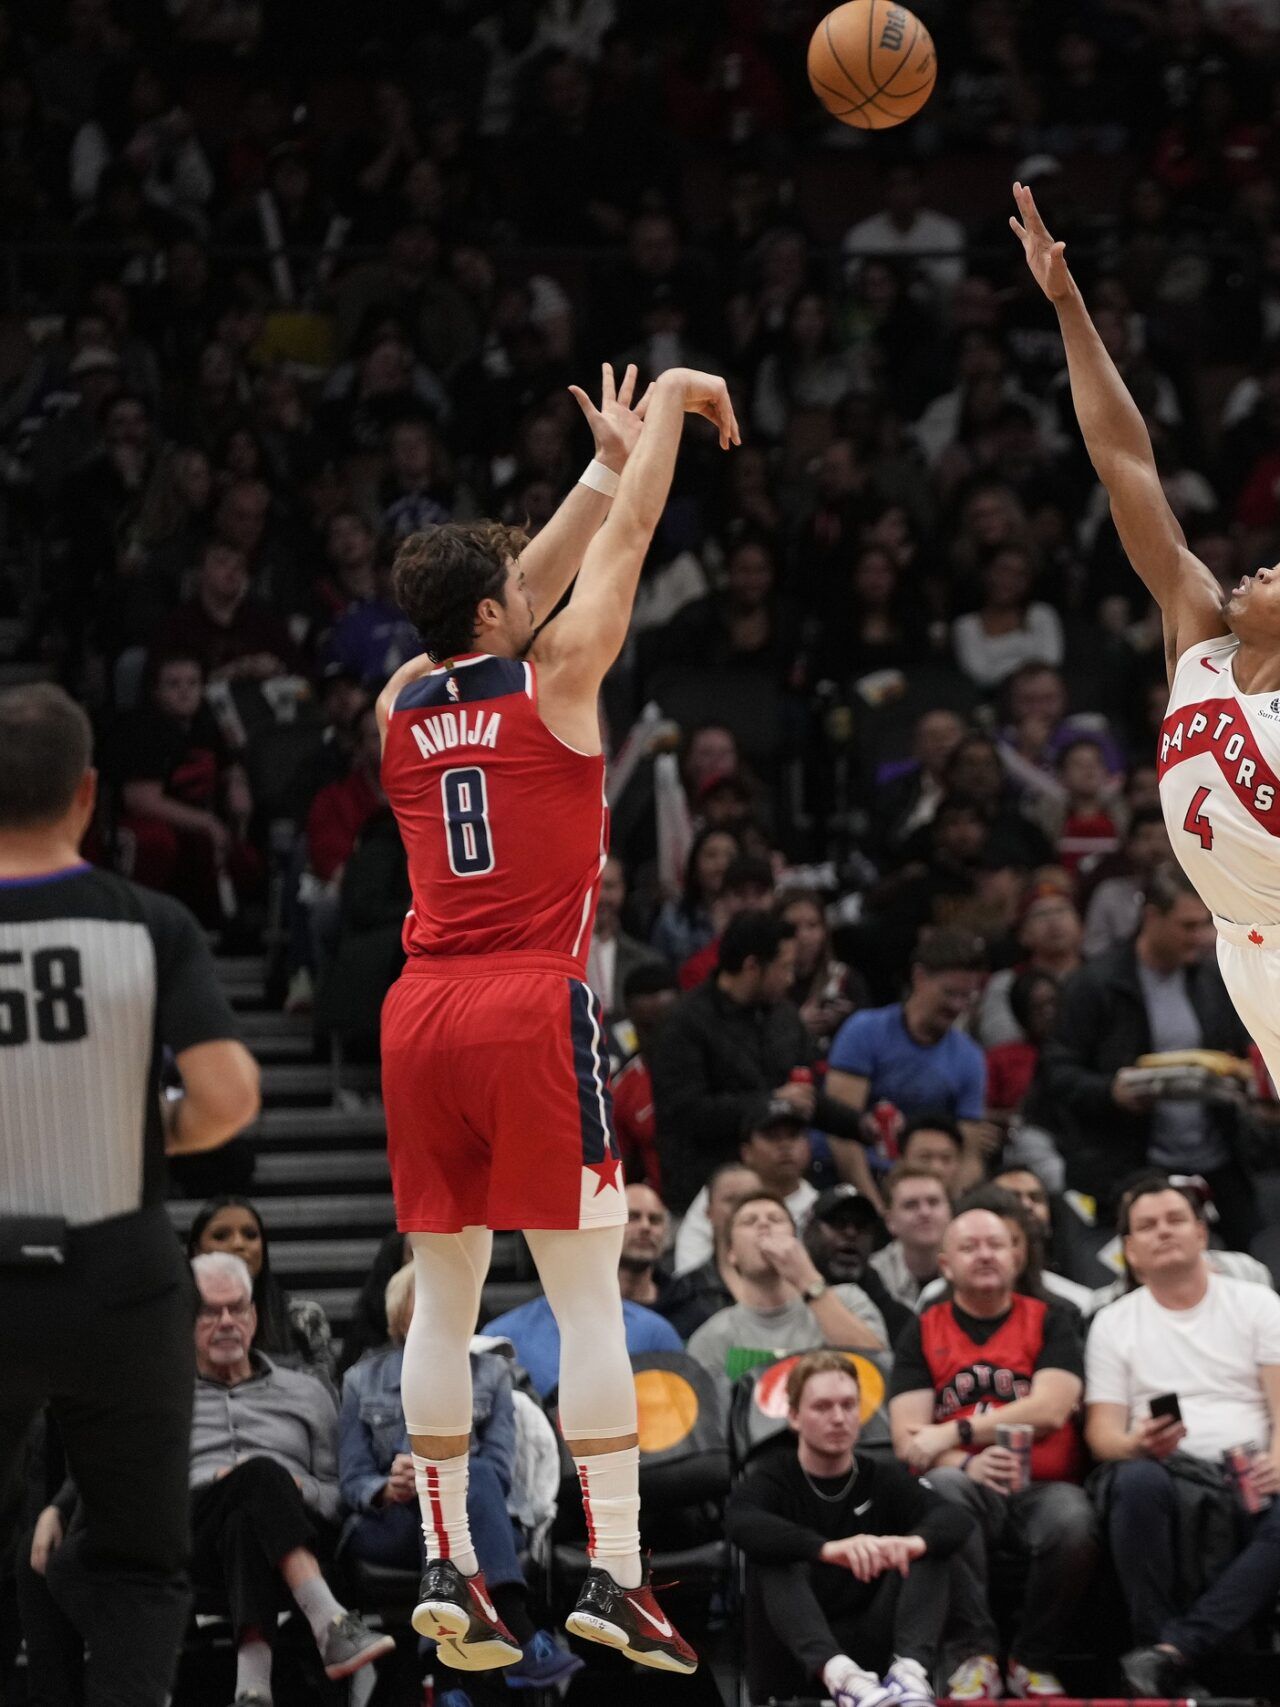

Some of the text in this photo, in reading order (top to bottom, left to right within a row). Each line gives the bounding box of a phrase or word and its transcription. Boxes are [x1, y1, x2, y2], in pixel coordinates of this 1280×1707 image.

[410, 709, 502, 760] AVDIJA
[1257, 709, 1274, 720] Sun
[1160, 712, 1275, 812] RAPTORS
[440, 765, 496, 878] 8
[1183, 786, 1214, 851] 4
